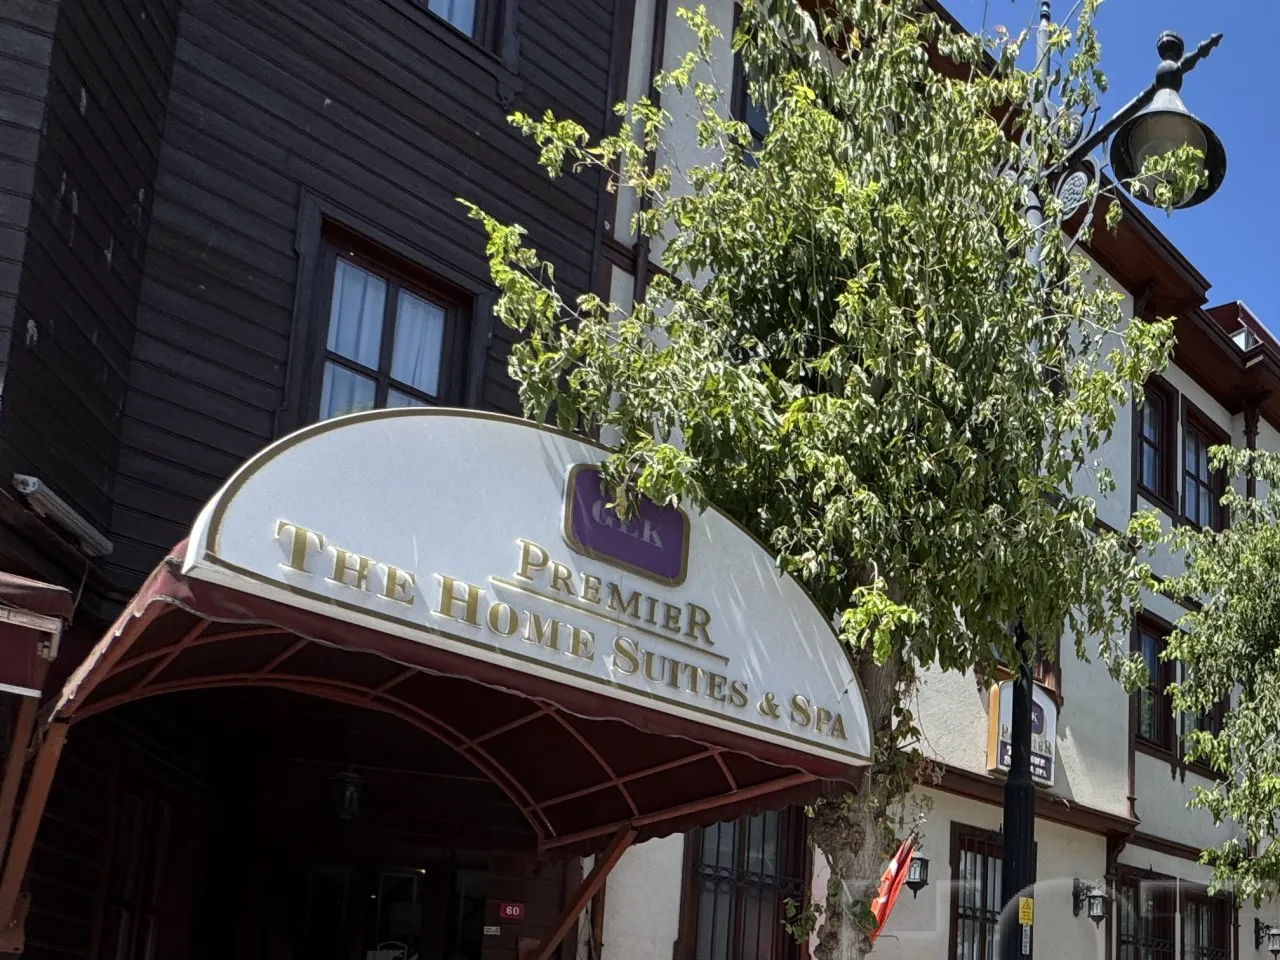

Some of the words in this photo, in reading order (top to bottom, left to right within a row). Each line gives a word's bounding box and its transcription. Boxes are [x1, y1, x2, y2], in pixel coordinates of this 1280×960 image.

[275, 519, 416, 608] THE
[429, 571, 595, 662] HOME
[611, 635, 748, 708] SUITES
[756, 691, 781, 720] &
[790, 692, 848, 740] SPA
[513, 538, 715, 646] PREMIER
[506, 905, 520, 916] 60
